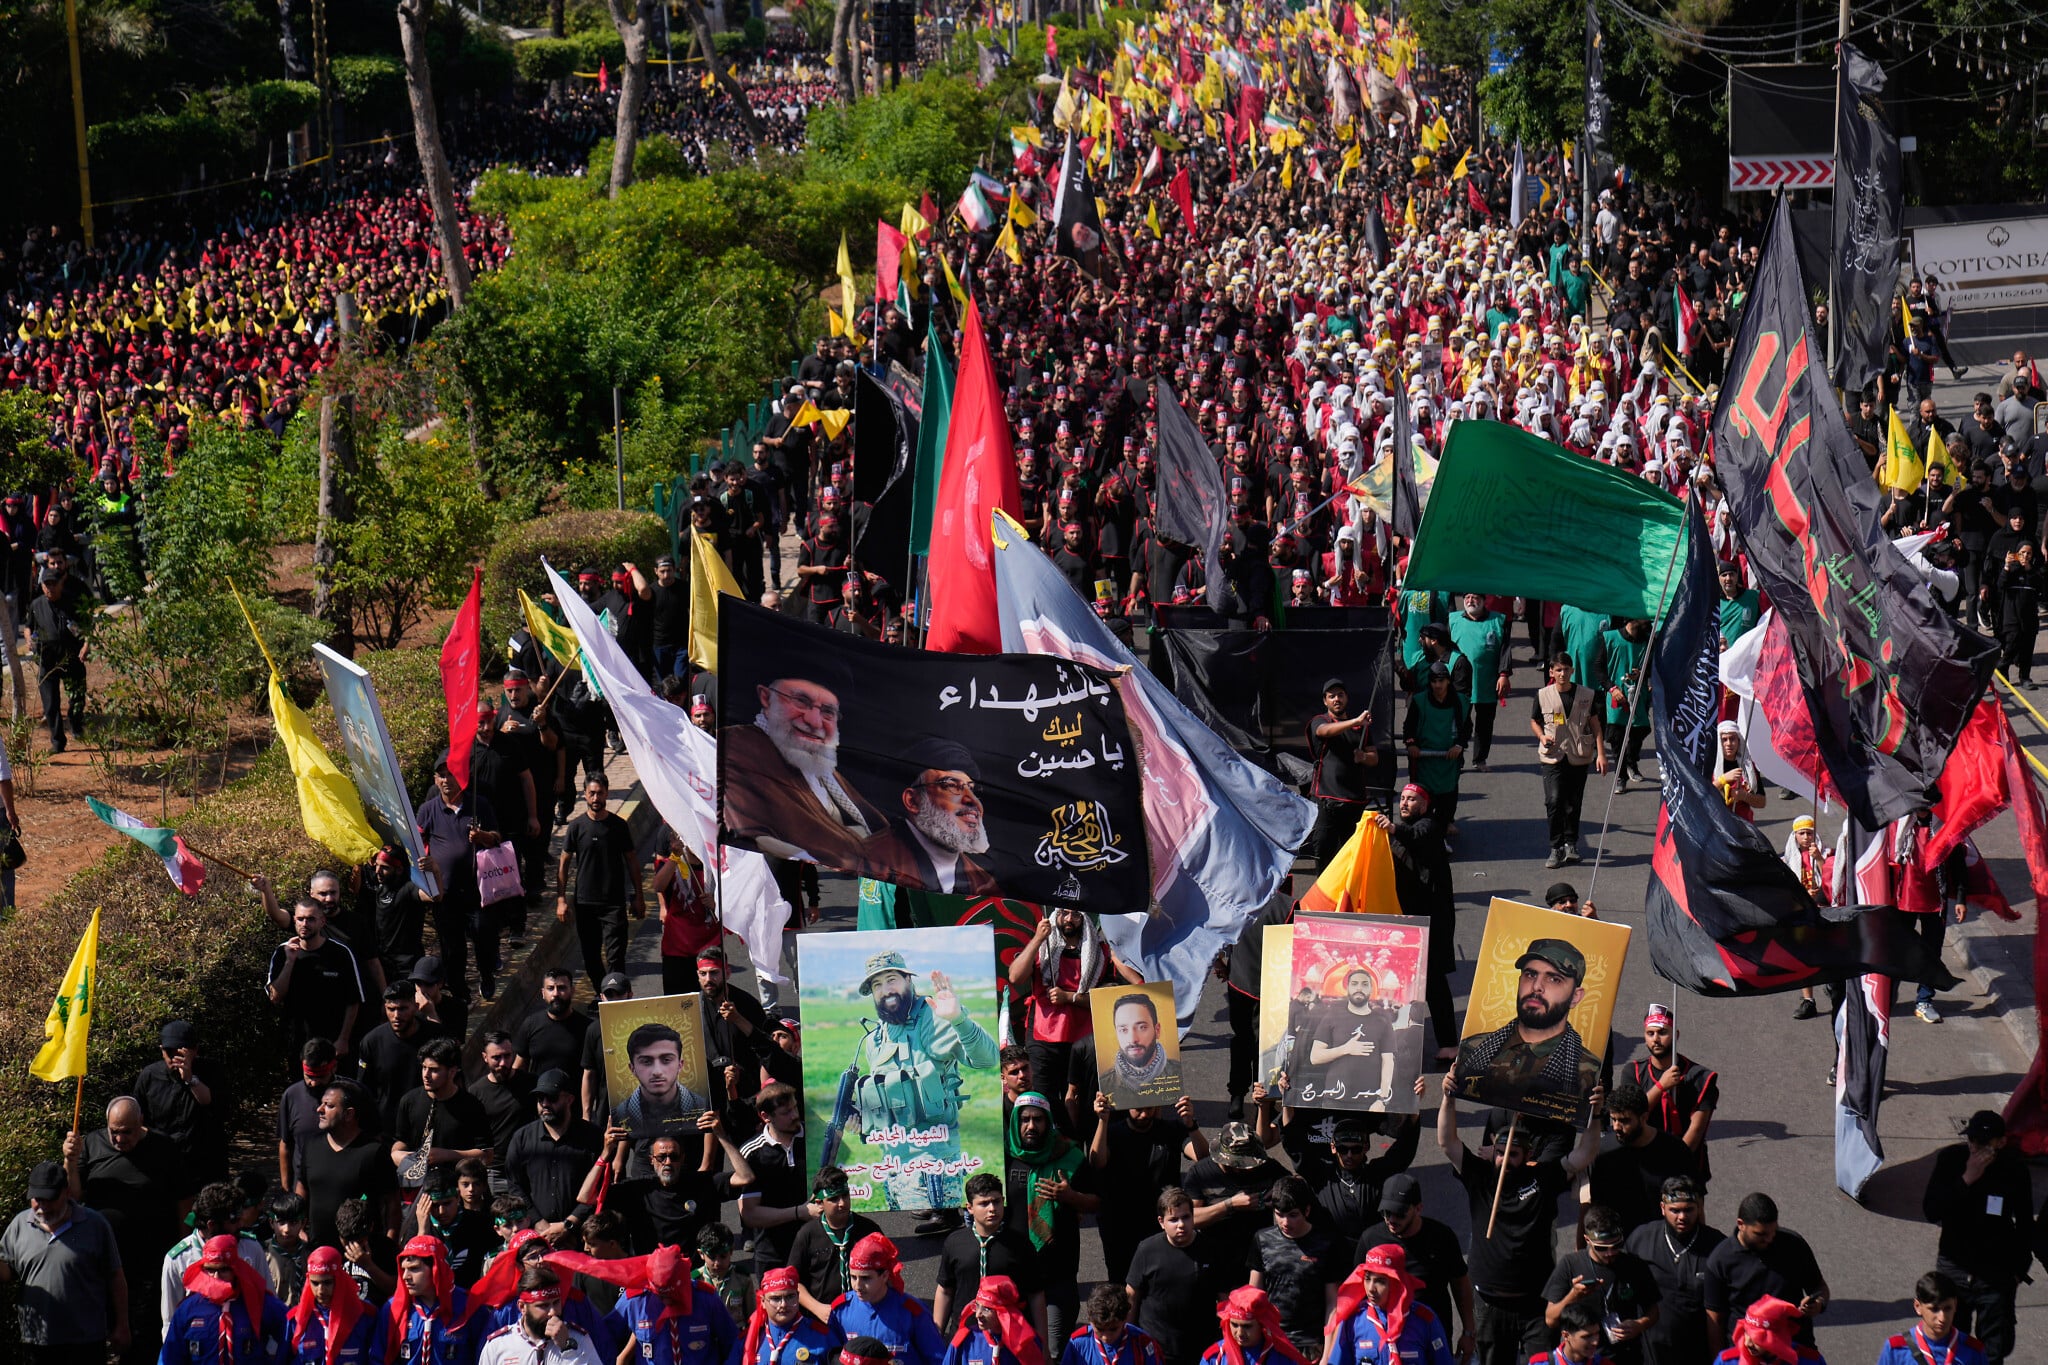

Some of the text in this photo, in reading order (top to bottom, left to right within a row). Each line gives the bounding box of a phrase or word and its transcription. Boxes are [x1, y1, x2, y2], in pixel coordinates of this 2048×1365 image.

[938, 665, 1111, 723] بالشهداء
[1042, 712, 1083, 748] لبيك
[1017, 733, 1125, 778] يا حسين
[1302, 1079, 1346, 1101] البرج
[867, 1125, 948, 1145] الشهيد المجاهد
[872, 1157, 899, 1180] الحج
[947, 1154, 981, 1174] عباس
